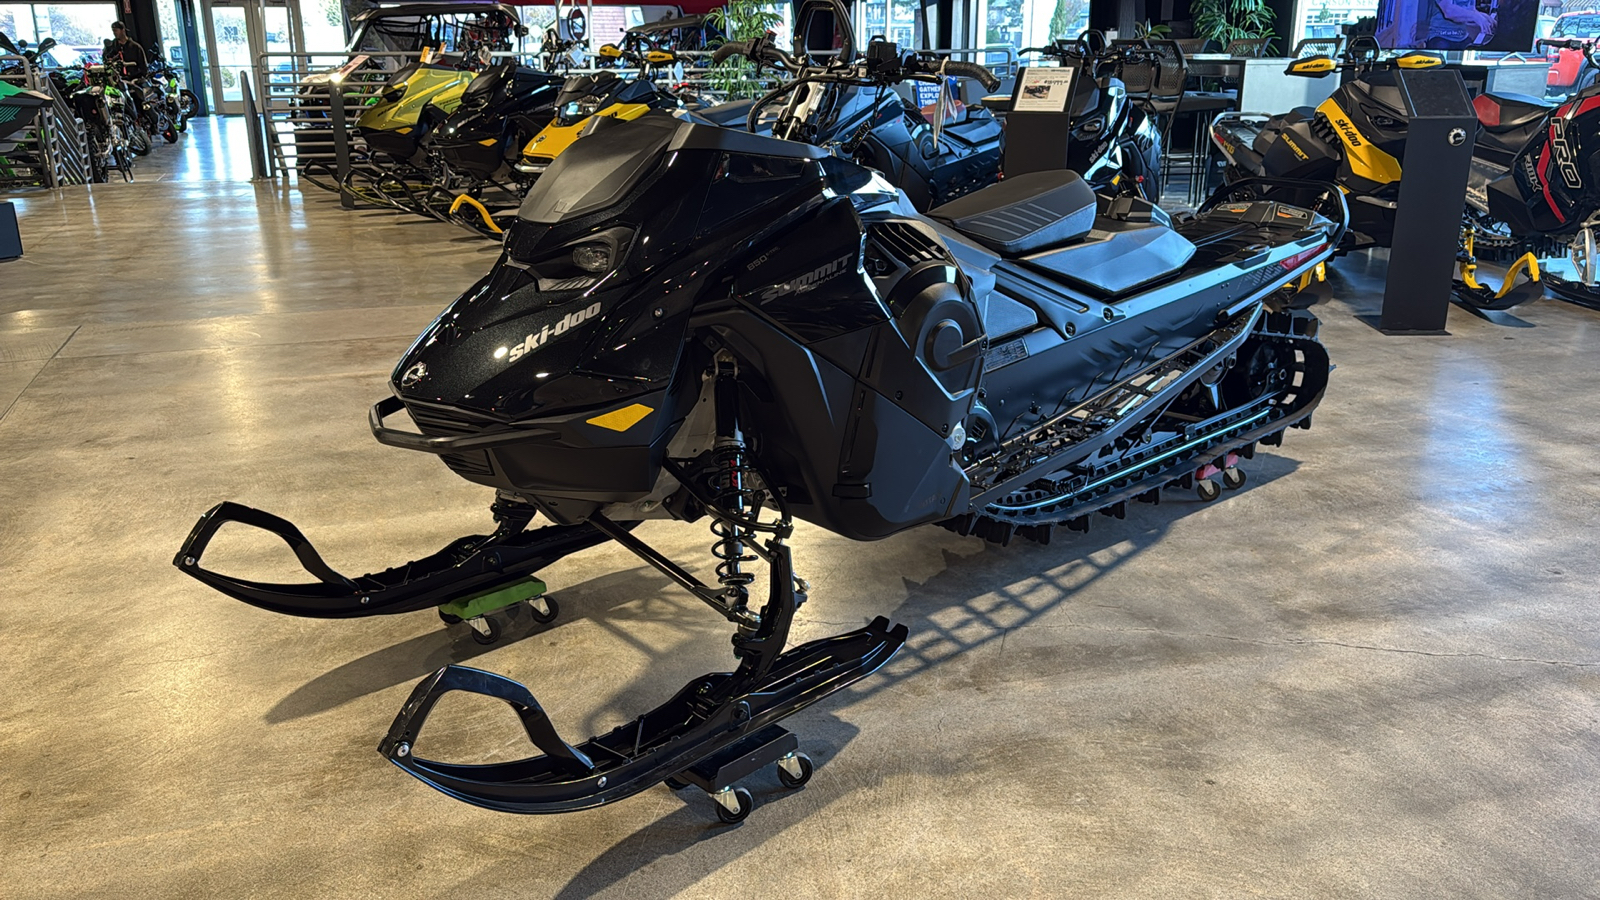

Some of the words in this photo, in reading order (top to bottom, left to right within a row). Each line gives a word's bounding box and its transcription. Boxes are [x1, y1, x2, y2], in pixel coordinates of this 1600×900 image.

[1281, 132, 1309, 160] SUMMIT
[1334, 118, 1362, 147] ski-doo
[1088, 140, 1108, 164] ski-doo
[1550, 117, 1582, 188] PRO
[746, 254, 768, 271] 850
[760, 252, 854, 306] SUMMIT
[508, 301, 602, 363] ski-doo
